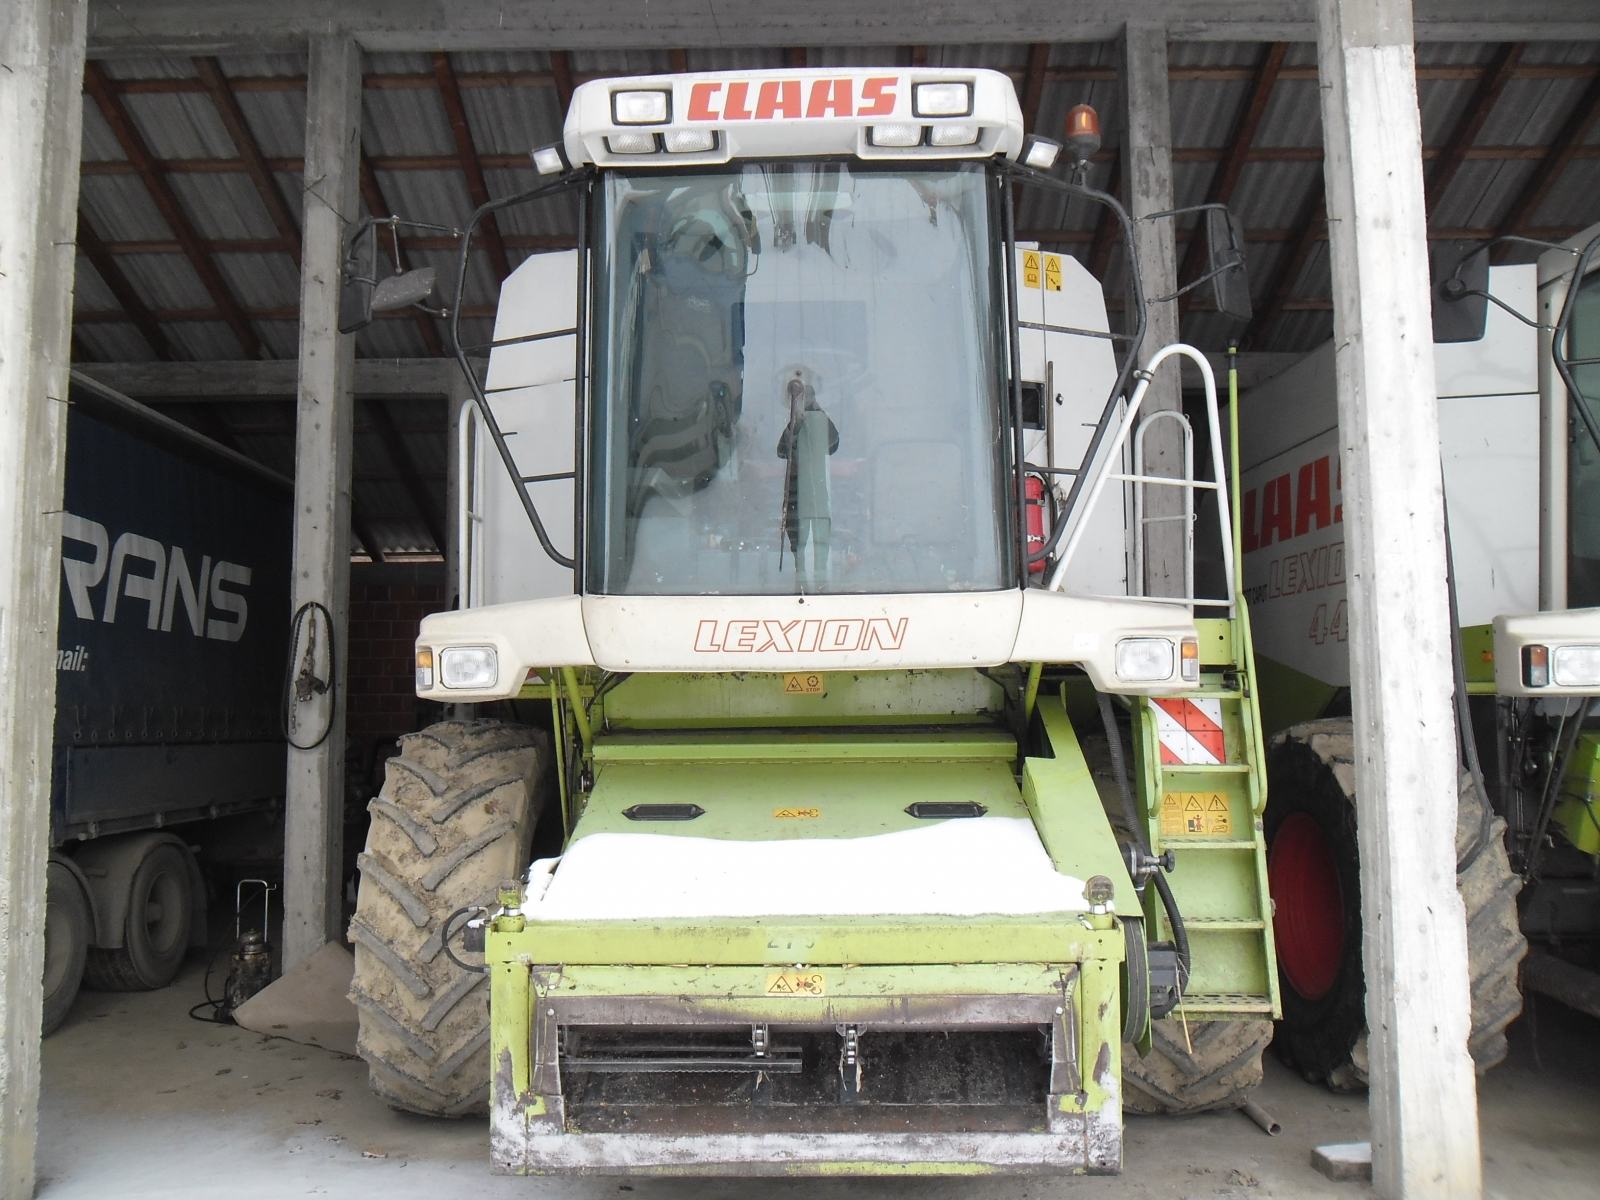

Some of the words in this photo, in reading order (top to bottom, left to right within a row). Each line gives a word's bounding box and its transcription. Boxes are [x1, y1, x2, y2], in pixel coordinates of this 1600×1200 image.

[687, 77, 898, 121] CLAAS
[1242, 456, 1343, 554] LAA
[694, 617, 908, 652] LEXION
